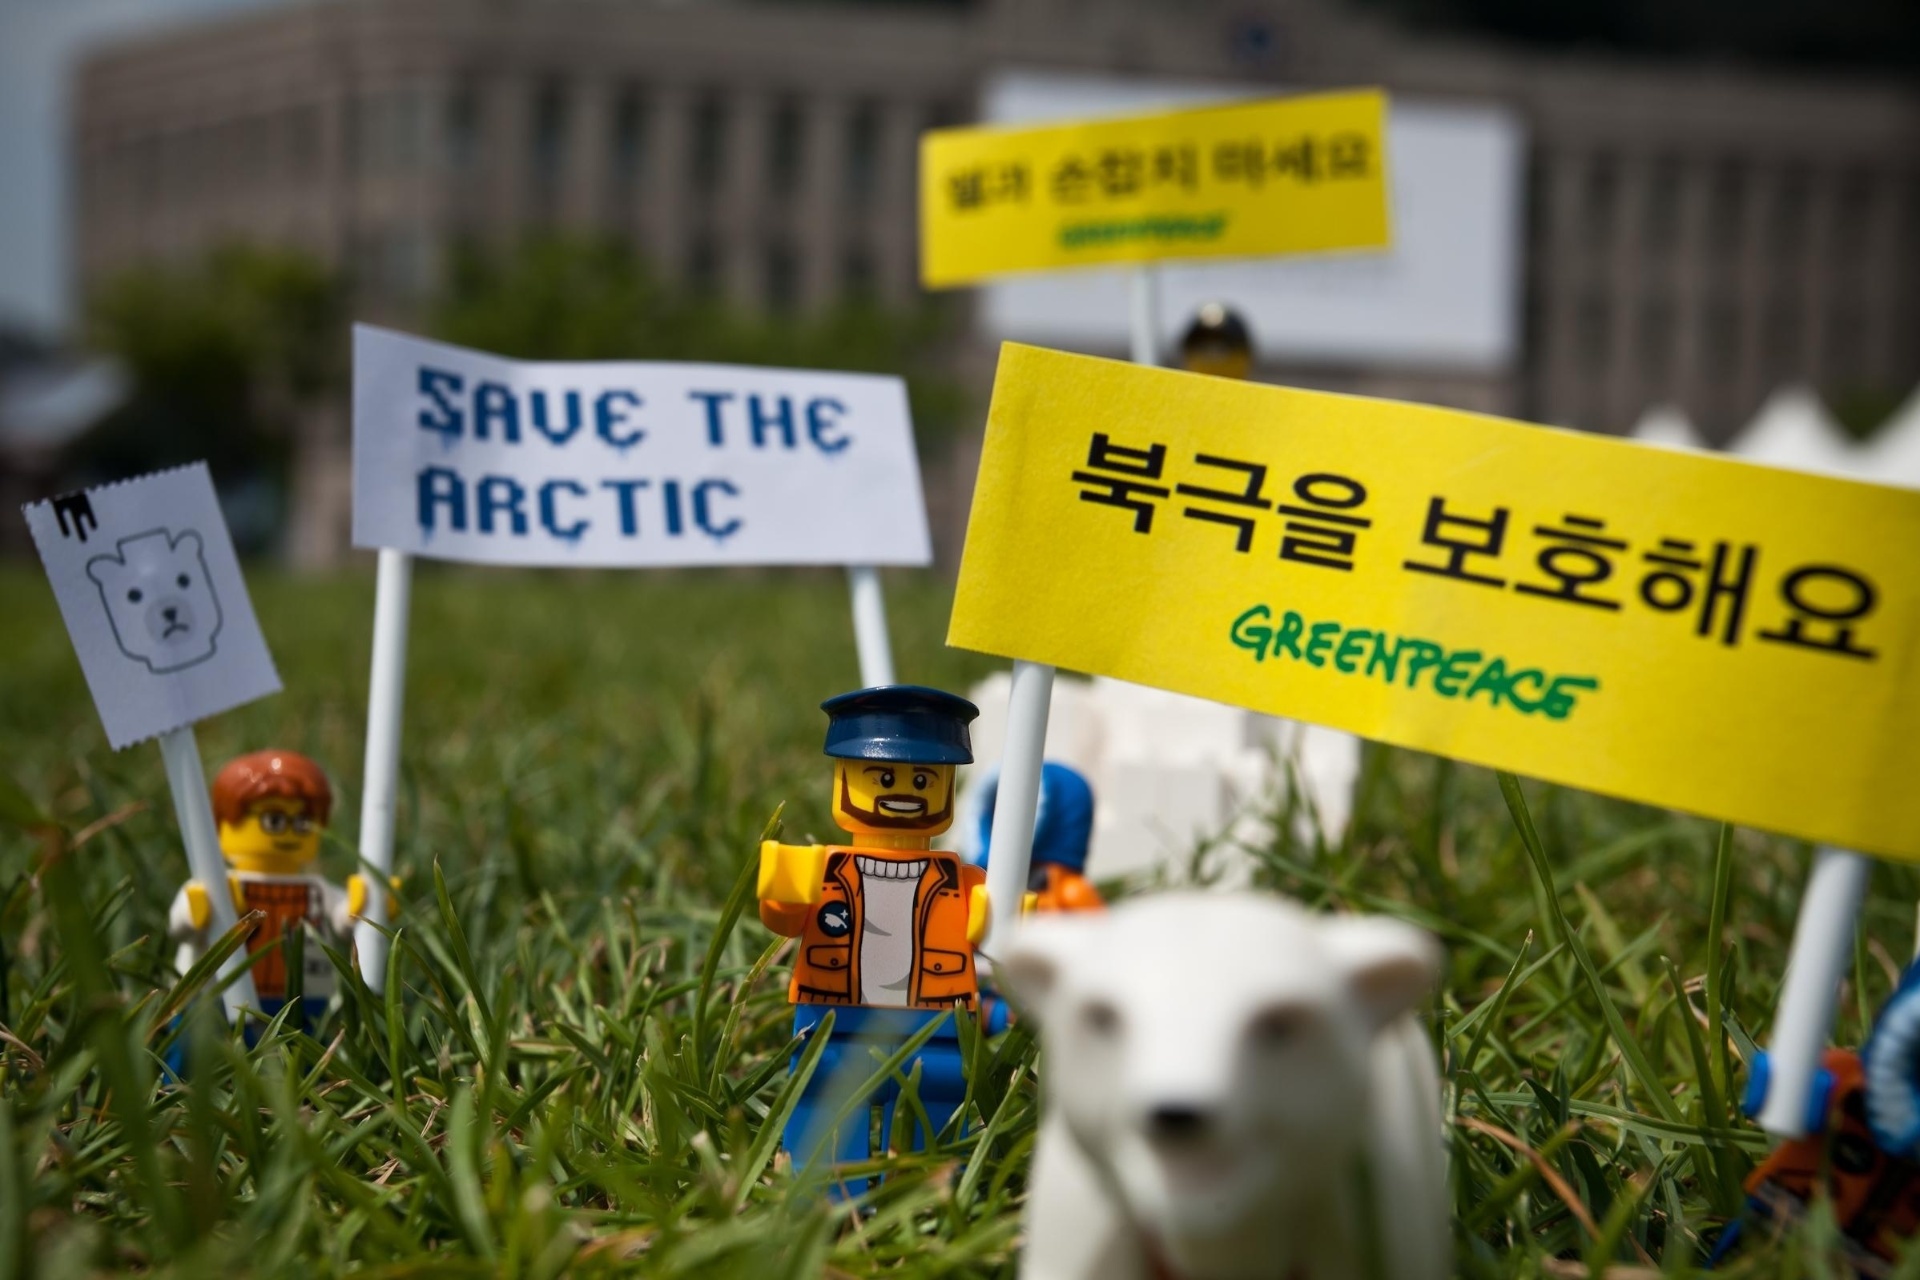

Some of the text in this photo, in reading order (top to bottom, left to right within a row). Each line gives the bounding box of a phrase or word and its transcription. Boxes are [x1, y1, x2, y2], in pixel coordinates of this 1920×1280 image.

[417, 366, 853, 460] SAVE THE
[417, 465, 743, 547] ARCTIC
[1071, 432, 1880, 661] 북극을 보호해요
[1230, 603, 1600, 720] GREENPEACE
